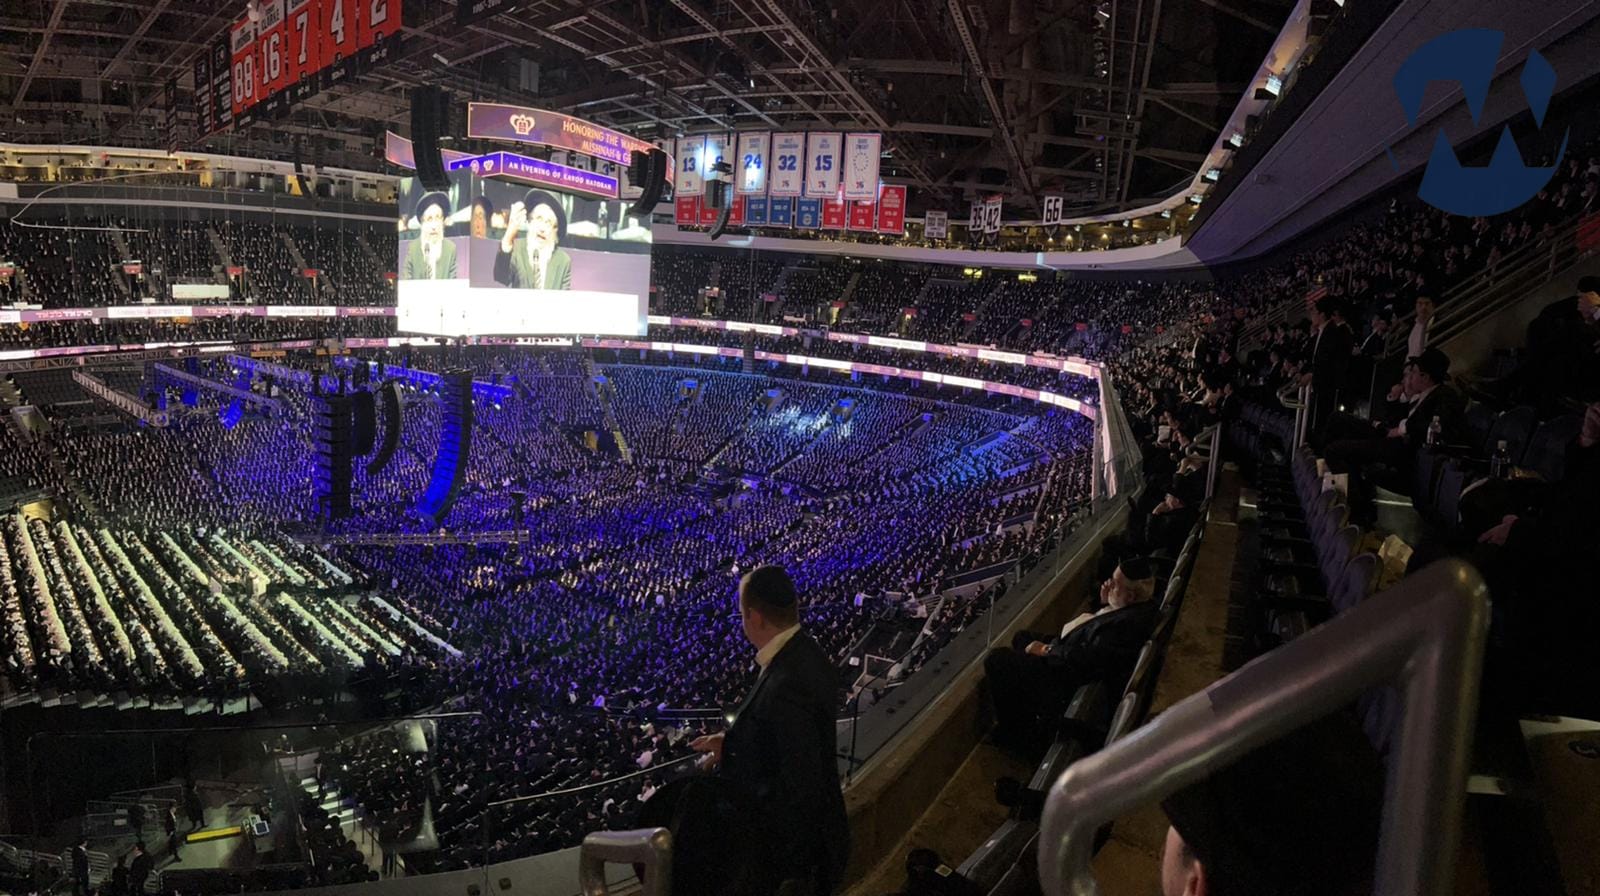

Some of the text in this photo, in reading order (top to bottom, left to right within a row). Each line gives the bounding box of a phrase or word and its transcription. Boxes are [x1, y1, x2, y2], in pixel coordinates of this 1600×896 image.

[331, 0, 345, 44] 4
[296, 11, 309, 65] 7
[262, 33, 280, 84] 16
[234, 54, 253, 103] 88
[563, 120, 604, 141] HONORING
[606, 133, 618, 147] THE
[508, 161, 519, 170] AN
[521, 164, 550, 177] EVENING
[552, 170, 561, 179] OF
[683, 157, 696, 172] 13
[743, 153, 763, 170] 24
[778, 155, 797, 170] 32
[814, 155, 833, 171] 15
[972, 207, 983, 228] 35
[987, 207, 999, 230] 42
[1045, 198, 1060, 223] 66
